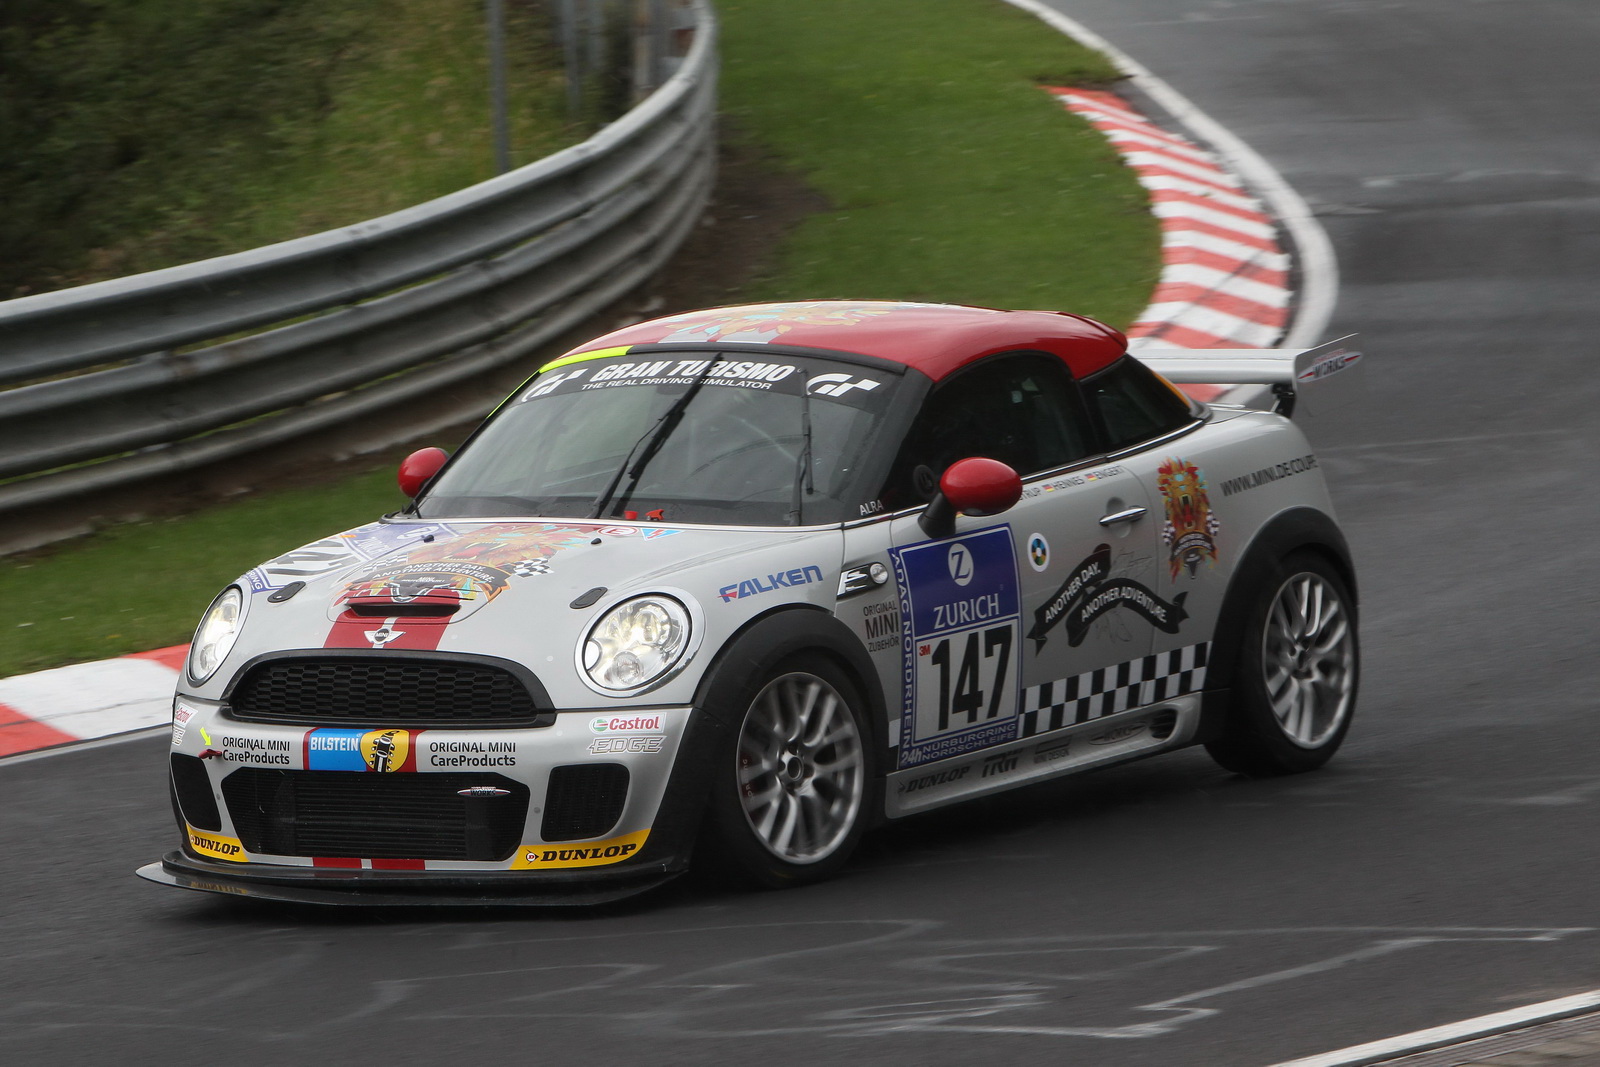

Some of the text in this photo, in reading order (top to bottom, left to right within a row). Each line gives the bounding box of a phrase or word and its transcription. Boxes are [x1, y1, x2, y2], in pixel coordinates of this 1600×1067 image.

[590, 360, 796, 383] GRAN TURISMO
[582, 382, 605, 390] THE
[606, 379, 638, 388] REAL
[641, 377, 694, 386] DRIVING
[859, 500, 884, 516] ALRA
[374, 567, 435, 579] ANOTHER
[405, 561, 487, 572] ANOTHER DAY.
[717, 565, 824, 604] FALKEN
[1045, 562, 1101, 623] ANOTHER DAY.
[863, 600, 897, 617] ORIGINAL
[933, 593, 999, 630] ZURICH
[1082, 586, 1167, 623] ANOTHER ADVENTURE
[864, 612, 899, 640] MINI
[868, 635, 900, 652] ZUBEHÖR
[892, 553, 913, 749] ADAC NORDRHEIN
[919, 644, 931, 657] 3M
[931, 624, 1013, 731] 147
[609, 716, 659, 731] Castrol
[222, 736, 290, 752] ORIGINAL MINI
[310, 736, 359, 752] BILSTEIN
[429, 742, 516, 753] ORIGINAL MINI
[589, 736, 665, 755] EDGE
[901, 723, 1016, 765] 24h NÜRBURGRING
[921, 731, 1015, 761] NORDSCHLEIFE
[222, 749, 290, 765] CareProducts
[430, 754, 516, 767] CareProducts
[905, 766, 971, 793] DUNLOP
[194, 836, 240, 855] DUNLOP
[541, 843, 637, 861] DUNLOP
